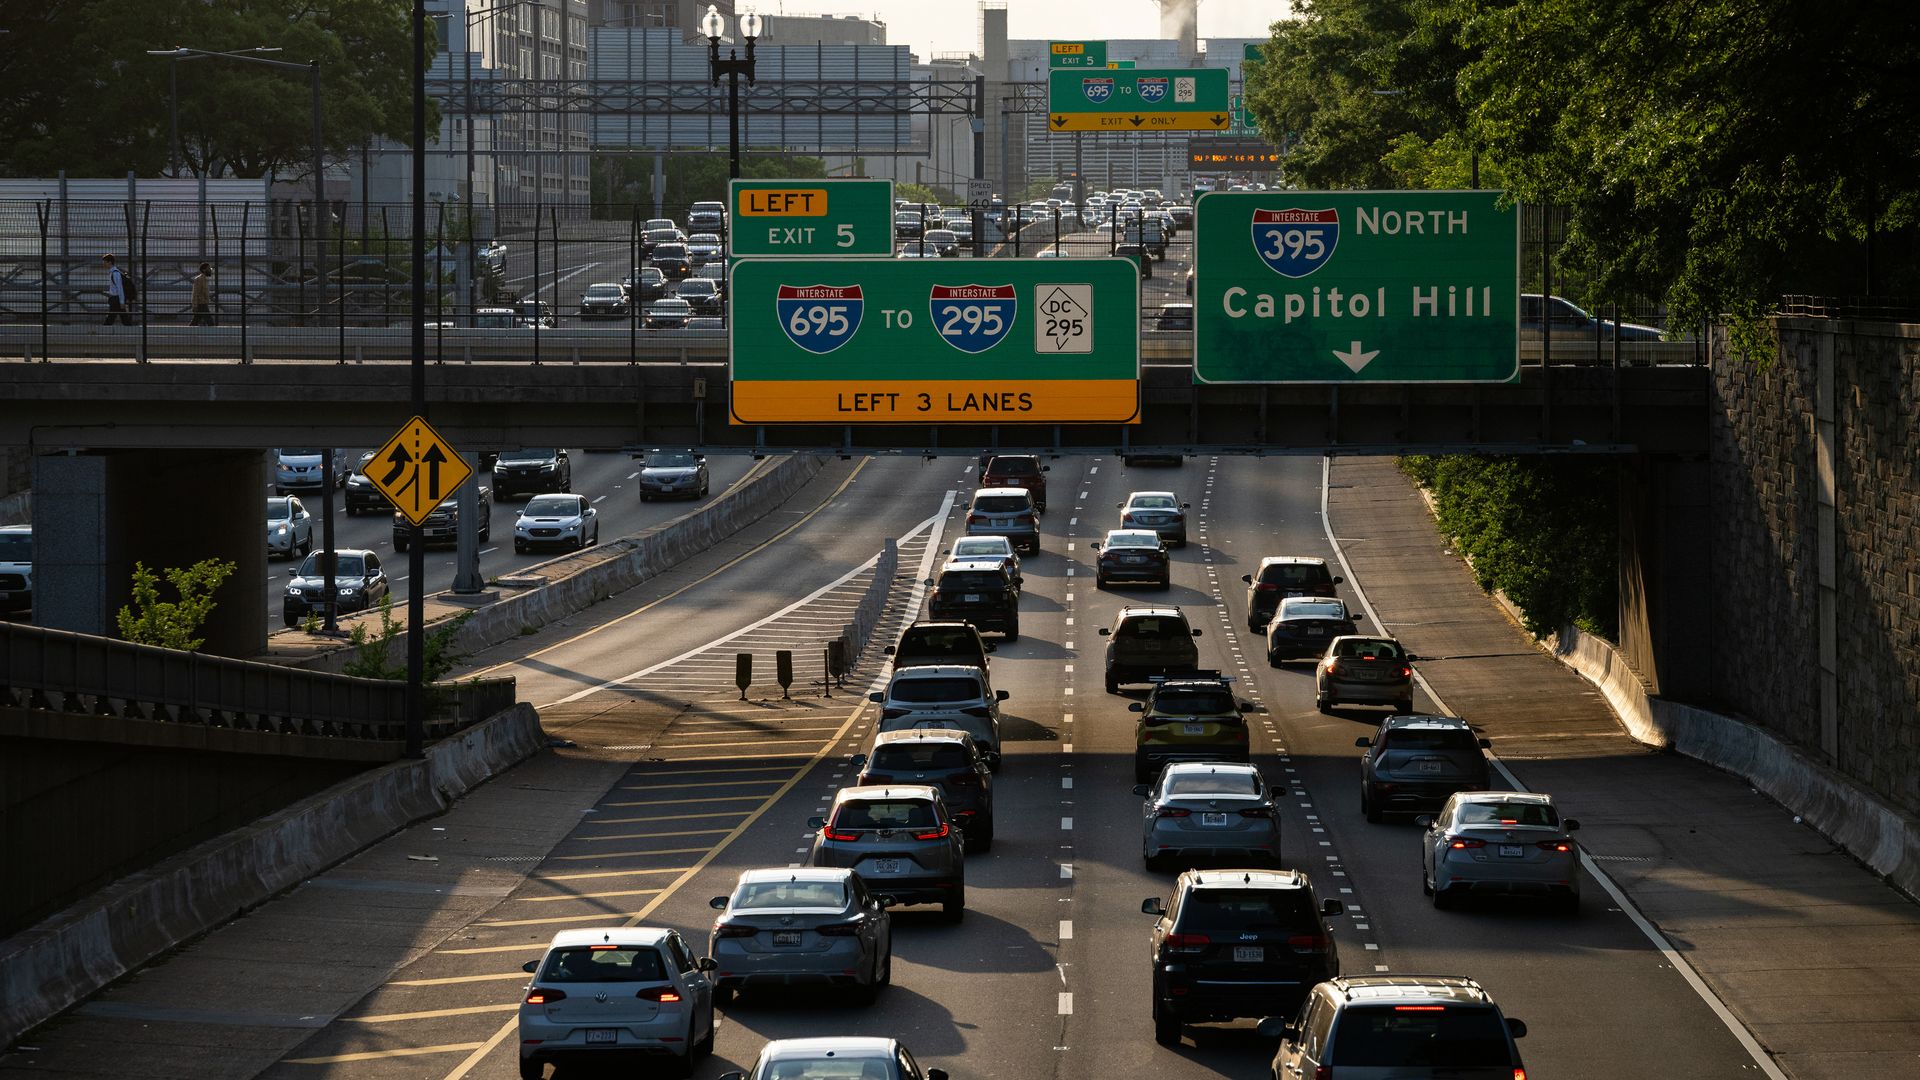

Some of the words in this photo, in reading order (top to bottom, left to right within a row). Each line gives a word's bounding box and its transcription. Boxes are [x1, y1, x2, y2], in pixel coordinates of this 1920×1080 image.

[1055, 45, 1079, 53] LEFT
[1062, 57, 1080, 65] EXIT
[1086, 56, 1094, 65] 5
[1087, 85, 1109, 97] 695
[1120, 86, 1132, 95] TO
[1141, 85, 1164, 97] 295
[1178, 89, 1193, 97] 295
[1101, 117, 1123, 126] EXIT
[1151, 117, 1177, 125] ONLY
[751, 194, 814, 212] LEFT
[970, 199, 990, 209] 40
[1271, 212, 1320, 222] INTERSTATE
[1356, 207, 1468, 235] NORTH
[769, 228, 816, 244] EXIT
[836, 224, 855, 248] 5
[1264, 230, 1326, 260] 395
[796, 289, 844, 298] INTERSTATE
[949, 288, 997, 298] INTERSTATE
[1050, 300, 1071, 313] DC
[1223, 286, 1385, 324] Capitol
[1413, 286, 1491, 317] Hill
[790, 305, 849, 336] 695
[881, 309, 913, 329] TO
[941, 305, 1004, 336] 295
[1045, 319, 1084, 337] 295
[838, 393, 900, 412] LEFT
[917, 393, 932, 412] 3
[948, 393, 1033, 412] LANES
[1240, 933, 1258, 941] Jeep
